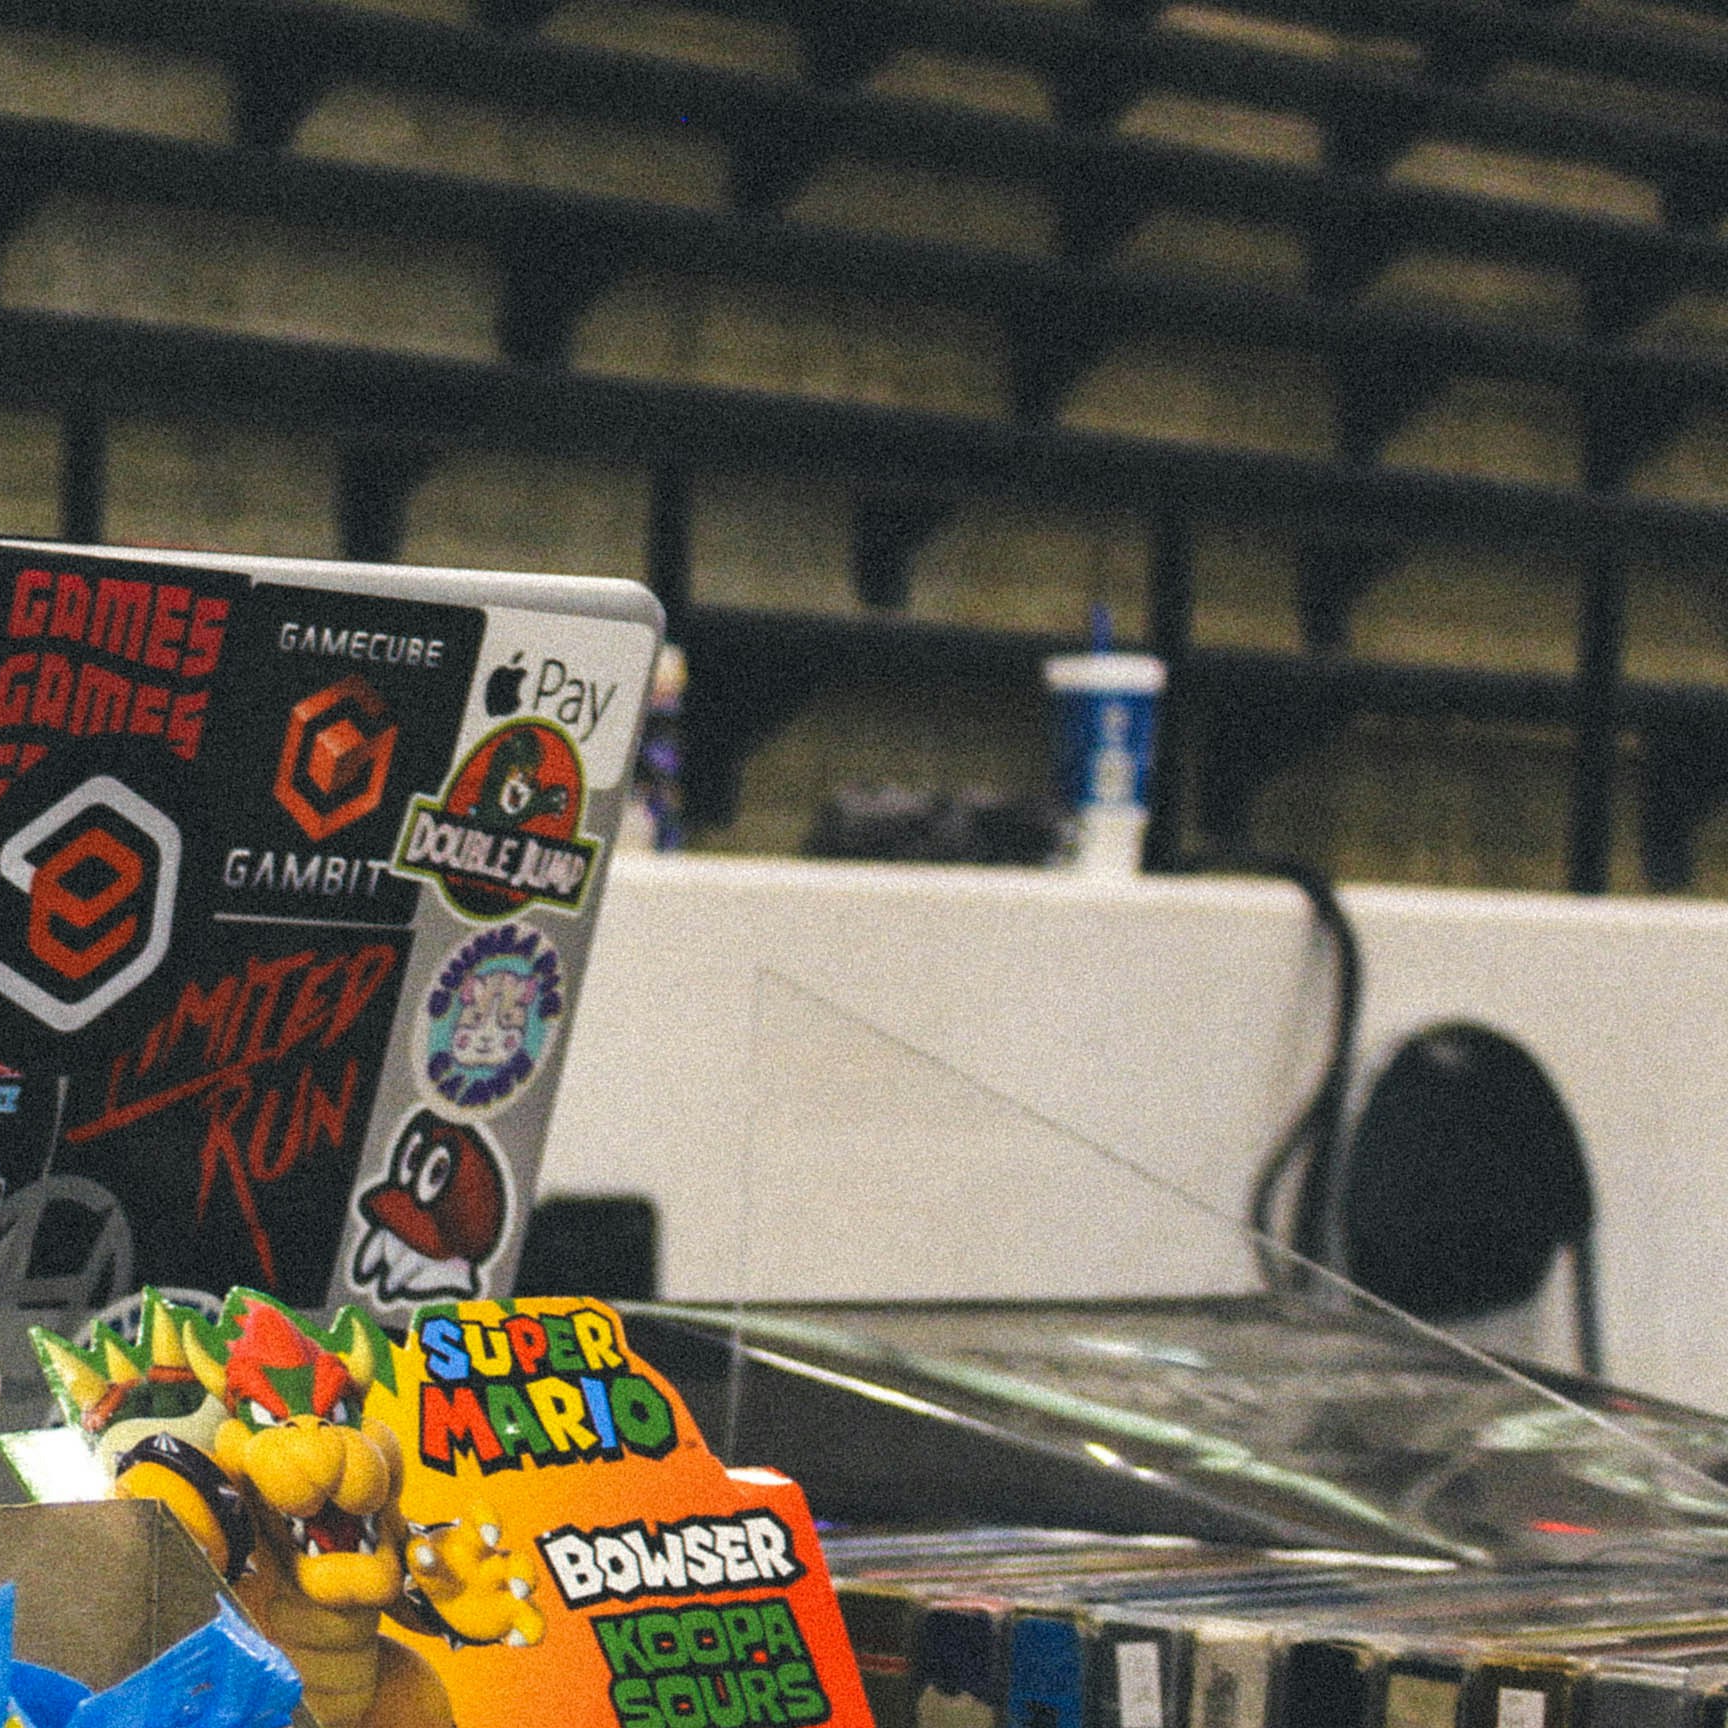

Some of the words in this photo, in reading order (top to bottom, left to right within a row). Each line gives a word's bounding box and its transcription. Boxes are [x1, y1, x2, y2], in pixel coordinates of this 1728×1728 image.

[6, 568, 231, 678] GAMES
[279, 621, 445, 669] GAMECUBE
[533, 658, 617, 743] Pay
[224, 848, 385, 899] GAMBIT
[405, 811, 521, 880] DOUBLE
[511, 838, 587, 895] JUMP
[196, 1058, 360, 1290] RUN
[418, 1307, 627, 1383] SUPER
[419, 1374, 678, 1475] MARIO
[538, 1508, 805, 1610] BOWSER
[592, 1597, 804, 1682] KOOPA
